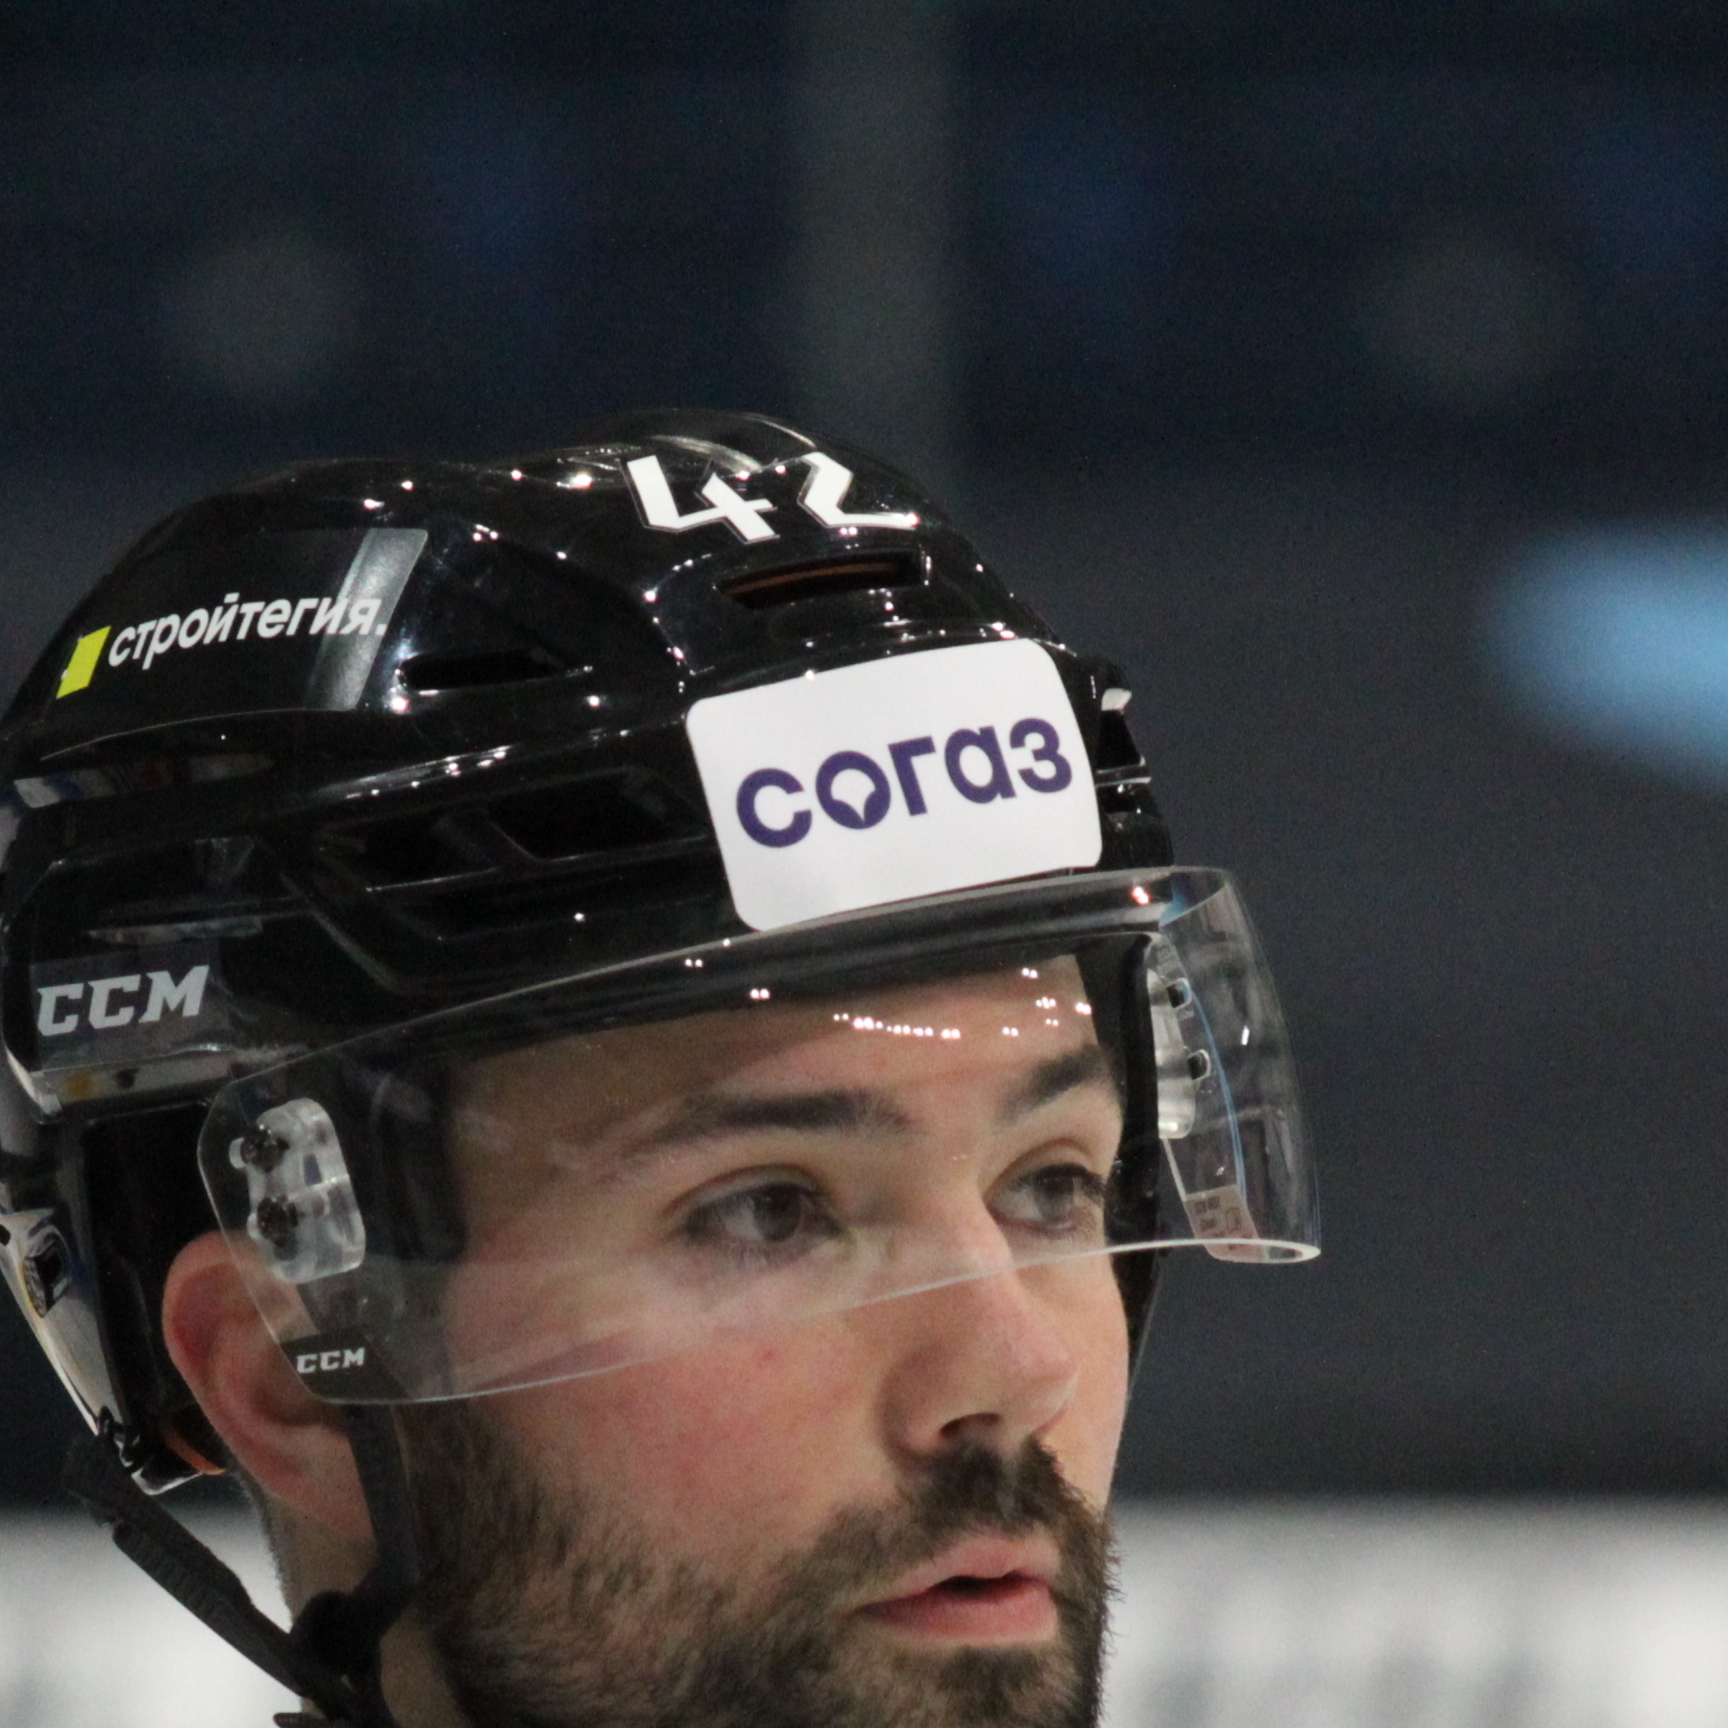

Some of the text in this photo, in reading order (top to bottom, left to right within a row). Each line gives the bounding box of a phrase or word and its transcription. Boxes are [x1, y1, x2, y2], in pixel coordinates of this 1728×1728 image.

[625, 451, 921, 542] 42
[735, 717, 1073, 848] согаз
[36, 964, 210, 1037] CCM
[296, 1346, 366, 1374] CCM
